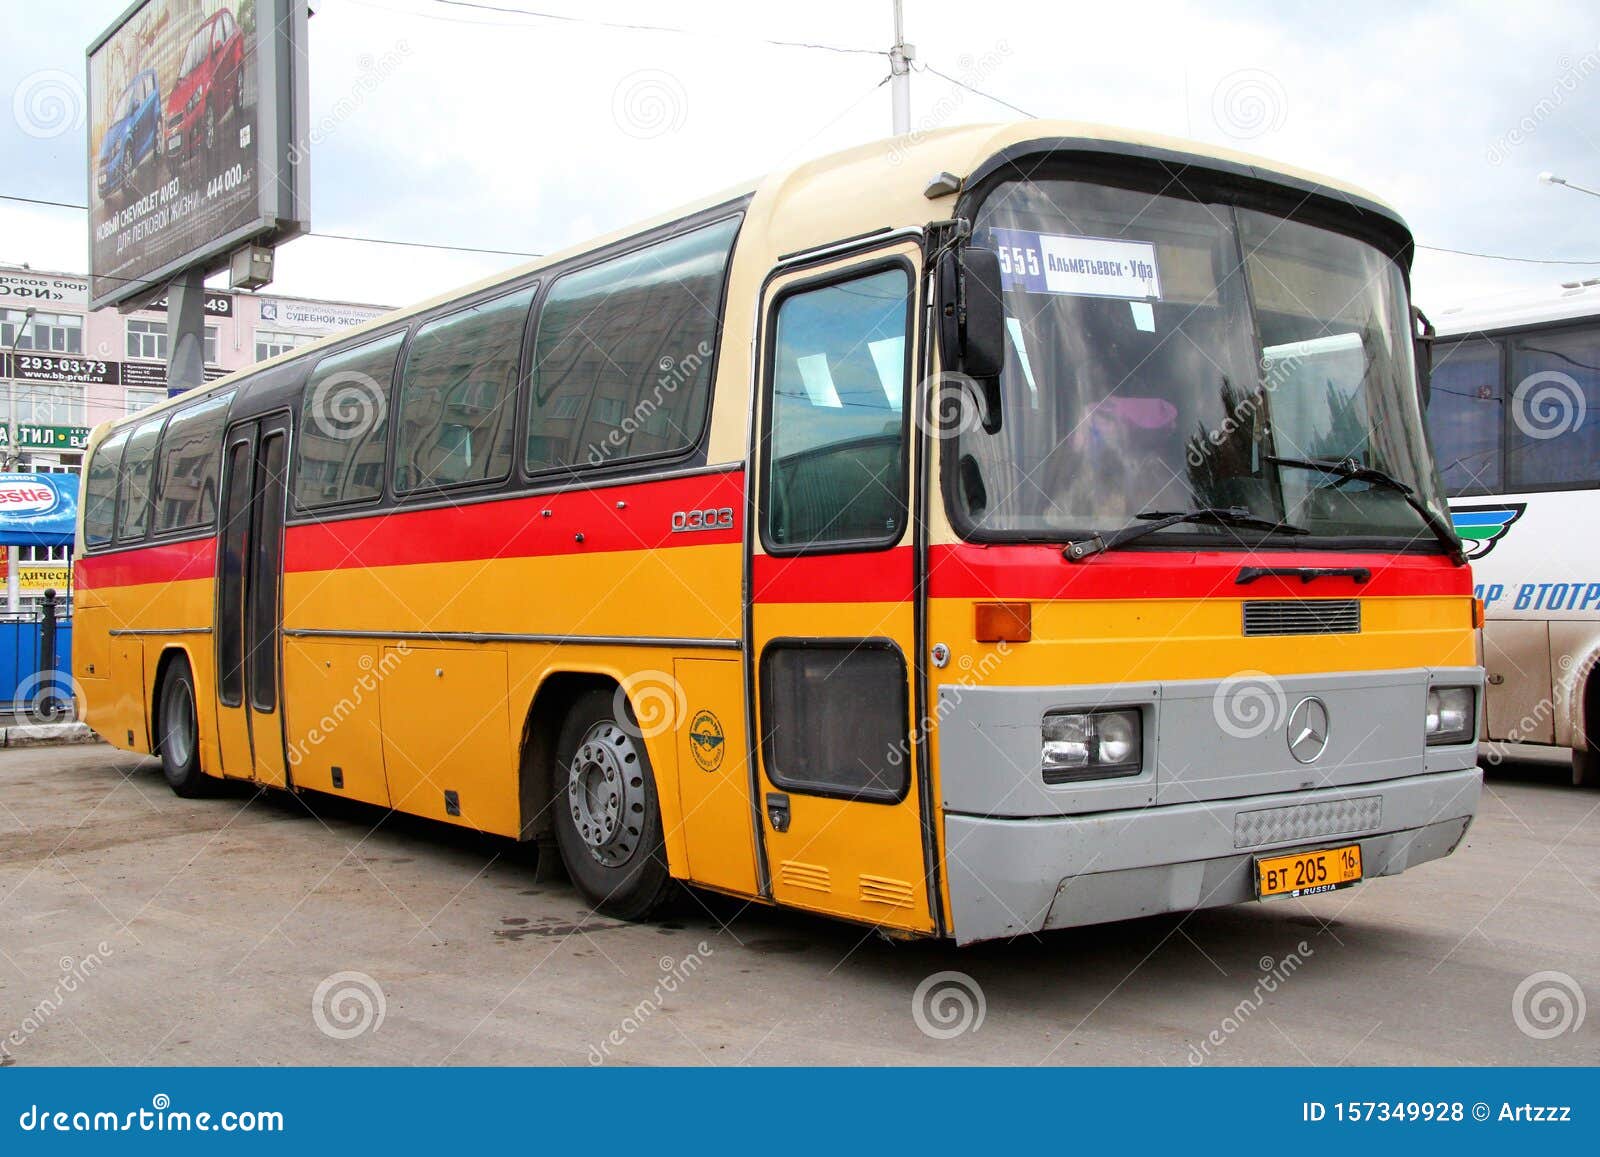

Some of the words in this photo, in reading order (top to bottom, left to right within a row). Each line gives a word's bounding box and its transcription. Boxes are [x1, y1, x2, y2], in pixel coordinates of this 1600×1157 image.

[207, 174, 223, 199] 444
[224, 163, 242, 191] 000
[120, 190, 159, 228] CHEVROLET
[160, 177, 180, 206] AVEO
[998, 246, 1040, 276] 555
[1048, 253, 1123, 277] Альметьевск
[1129, 259, 1153, 282] Уфа
[20, 357, 107, 375] 293-03-73
[24, 371, 103, 382] www.bb-profi.ru
[1513, 583, 1600, 610] ВТОТР
[1295, 856, 1327, 886] 205
[1341, 850, 1355, 869] 16
[1303, 884, 1337, 896] RUSSIA
